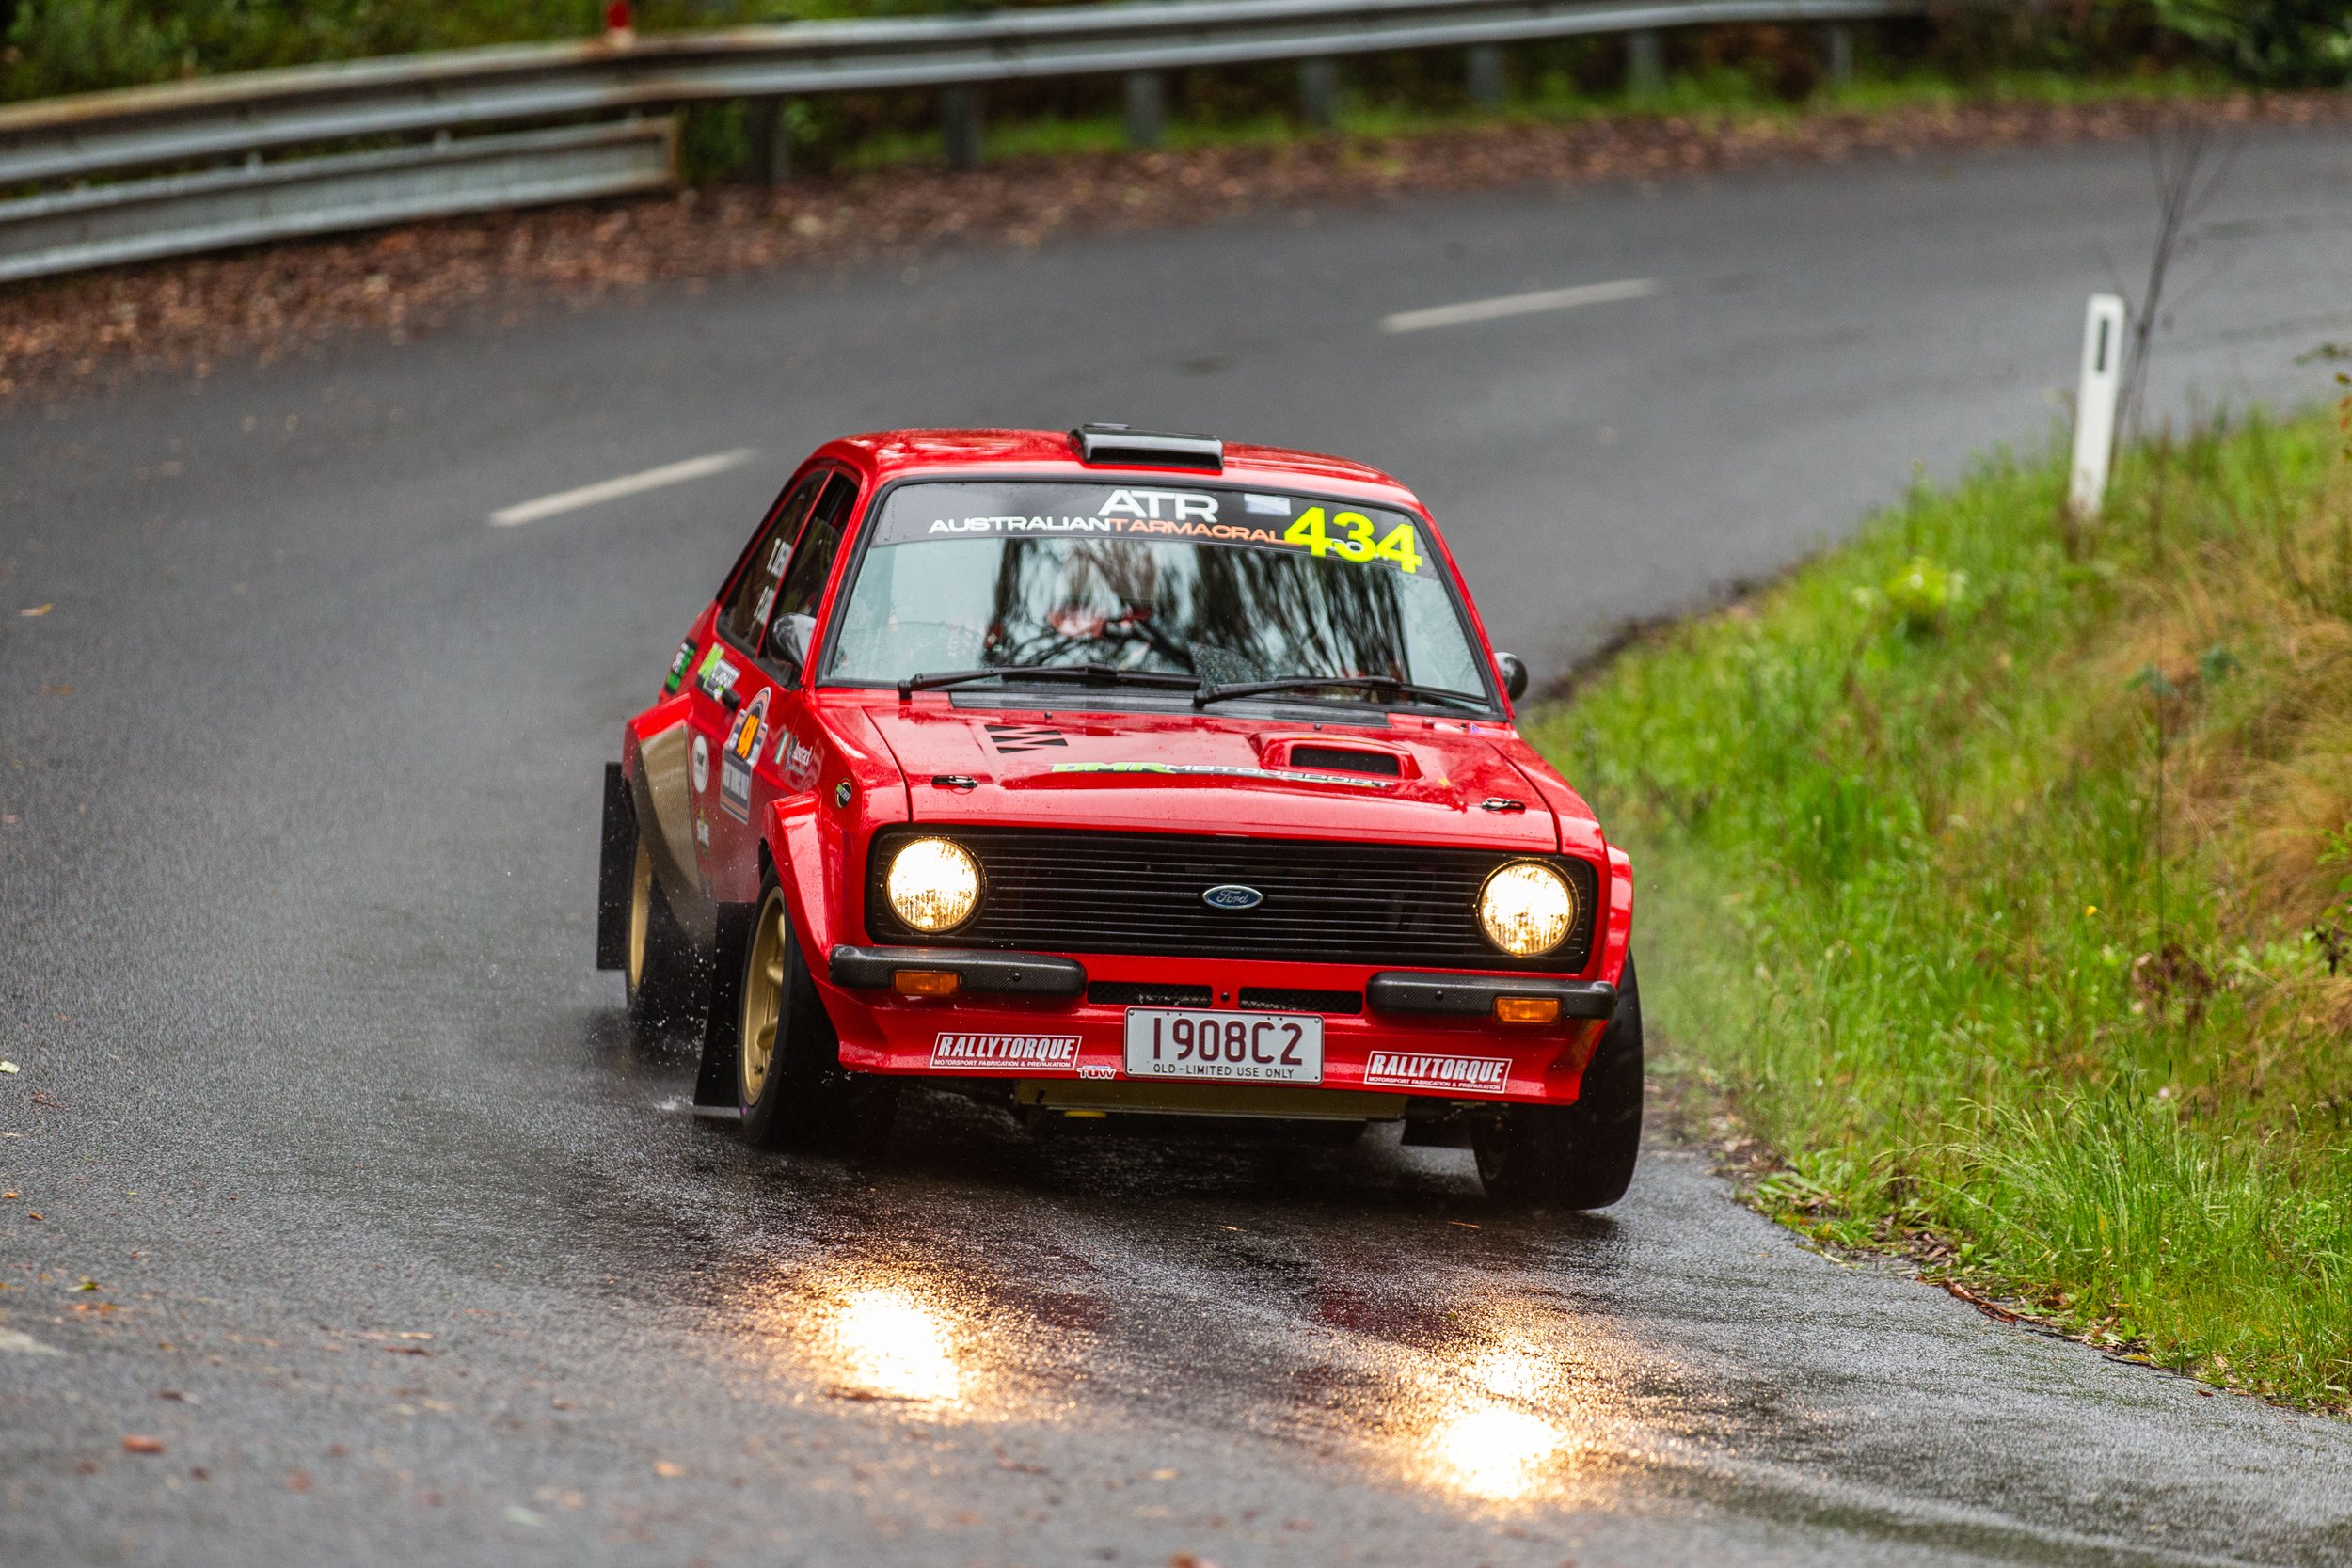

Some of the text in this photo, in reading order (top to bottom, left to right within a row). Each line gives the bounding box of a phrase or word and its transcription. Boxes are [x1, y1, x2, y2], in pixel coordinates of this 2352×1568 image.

[1098, 489, 1218, 523] ATR
[1284, 506, 1422, 574] 434
[1216, 890, 1249, 903] Ford
[937, 1037, 1075, 1061] RALLYTORQUE
[1153, 1017, 1303, 1066] 1908C2
[1236, 1067, 1261, 1078] USE
[1265, 1067, 1295, 1080] ONLY
[1371, 1054, 1505, 1083] RALLYTORQUE
[1411, 1079, 1451, 1087] FABRICATION
